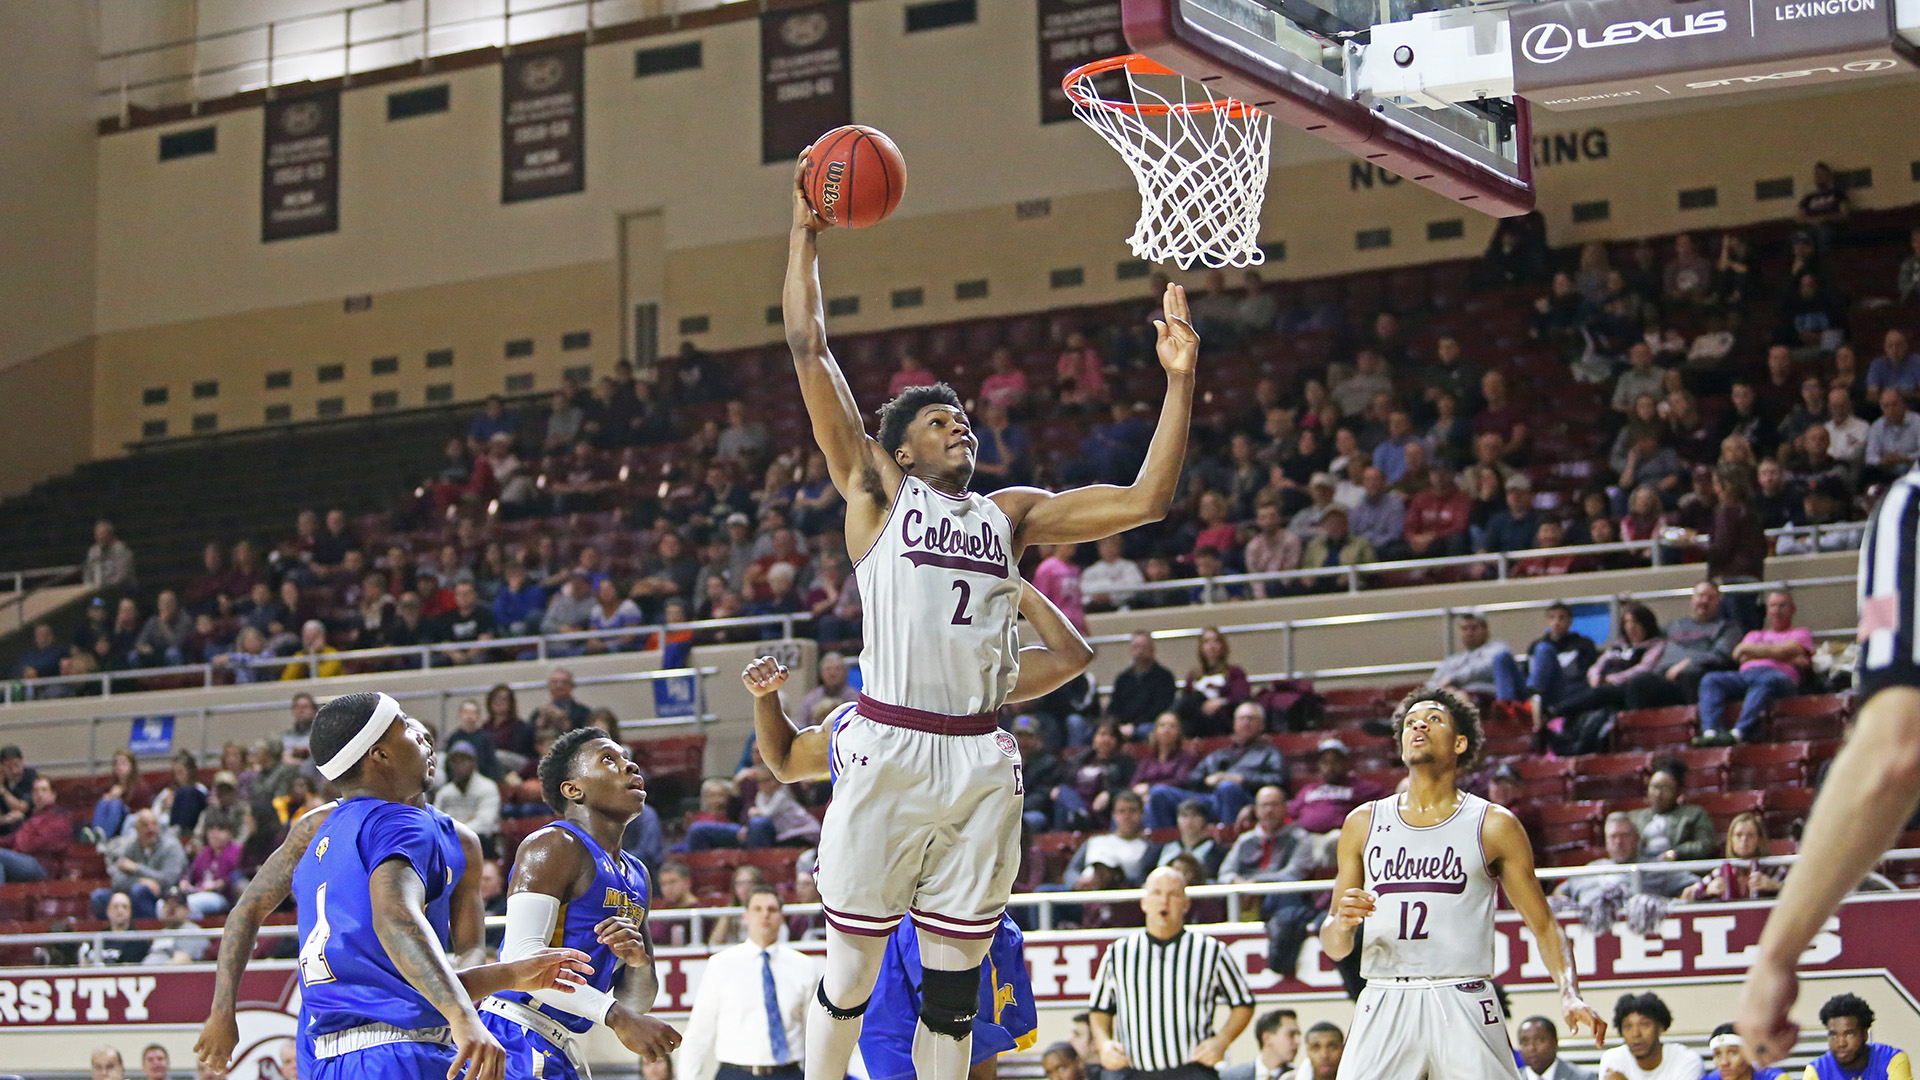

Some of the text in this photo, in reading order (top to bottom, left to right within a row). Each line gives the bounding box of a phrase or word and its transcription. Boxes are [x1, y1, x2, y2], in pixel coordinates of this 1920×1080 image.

[1576, 10, 1728, 49] LEXUS
[1775, 0, 1876, 21] LEXINGTON
[902, 508, 1006, 566] Colonels
[950, 579, 973, 626] 2
[1368, 845, 1466, 883] Colonels
[1397, 900, 1430, 941] 12
[1479, 998, 1500, 1026] E
